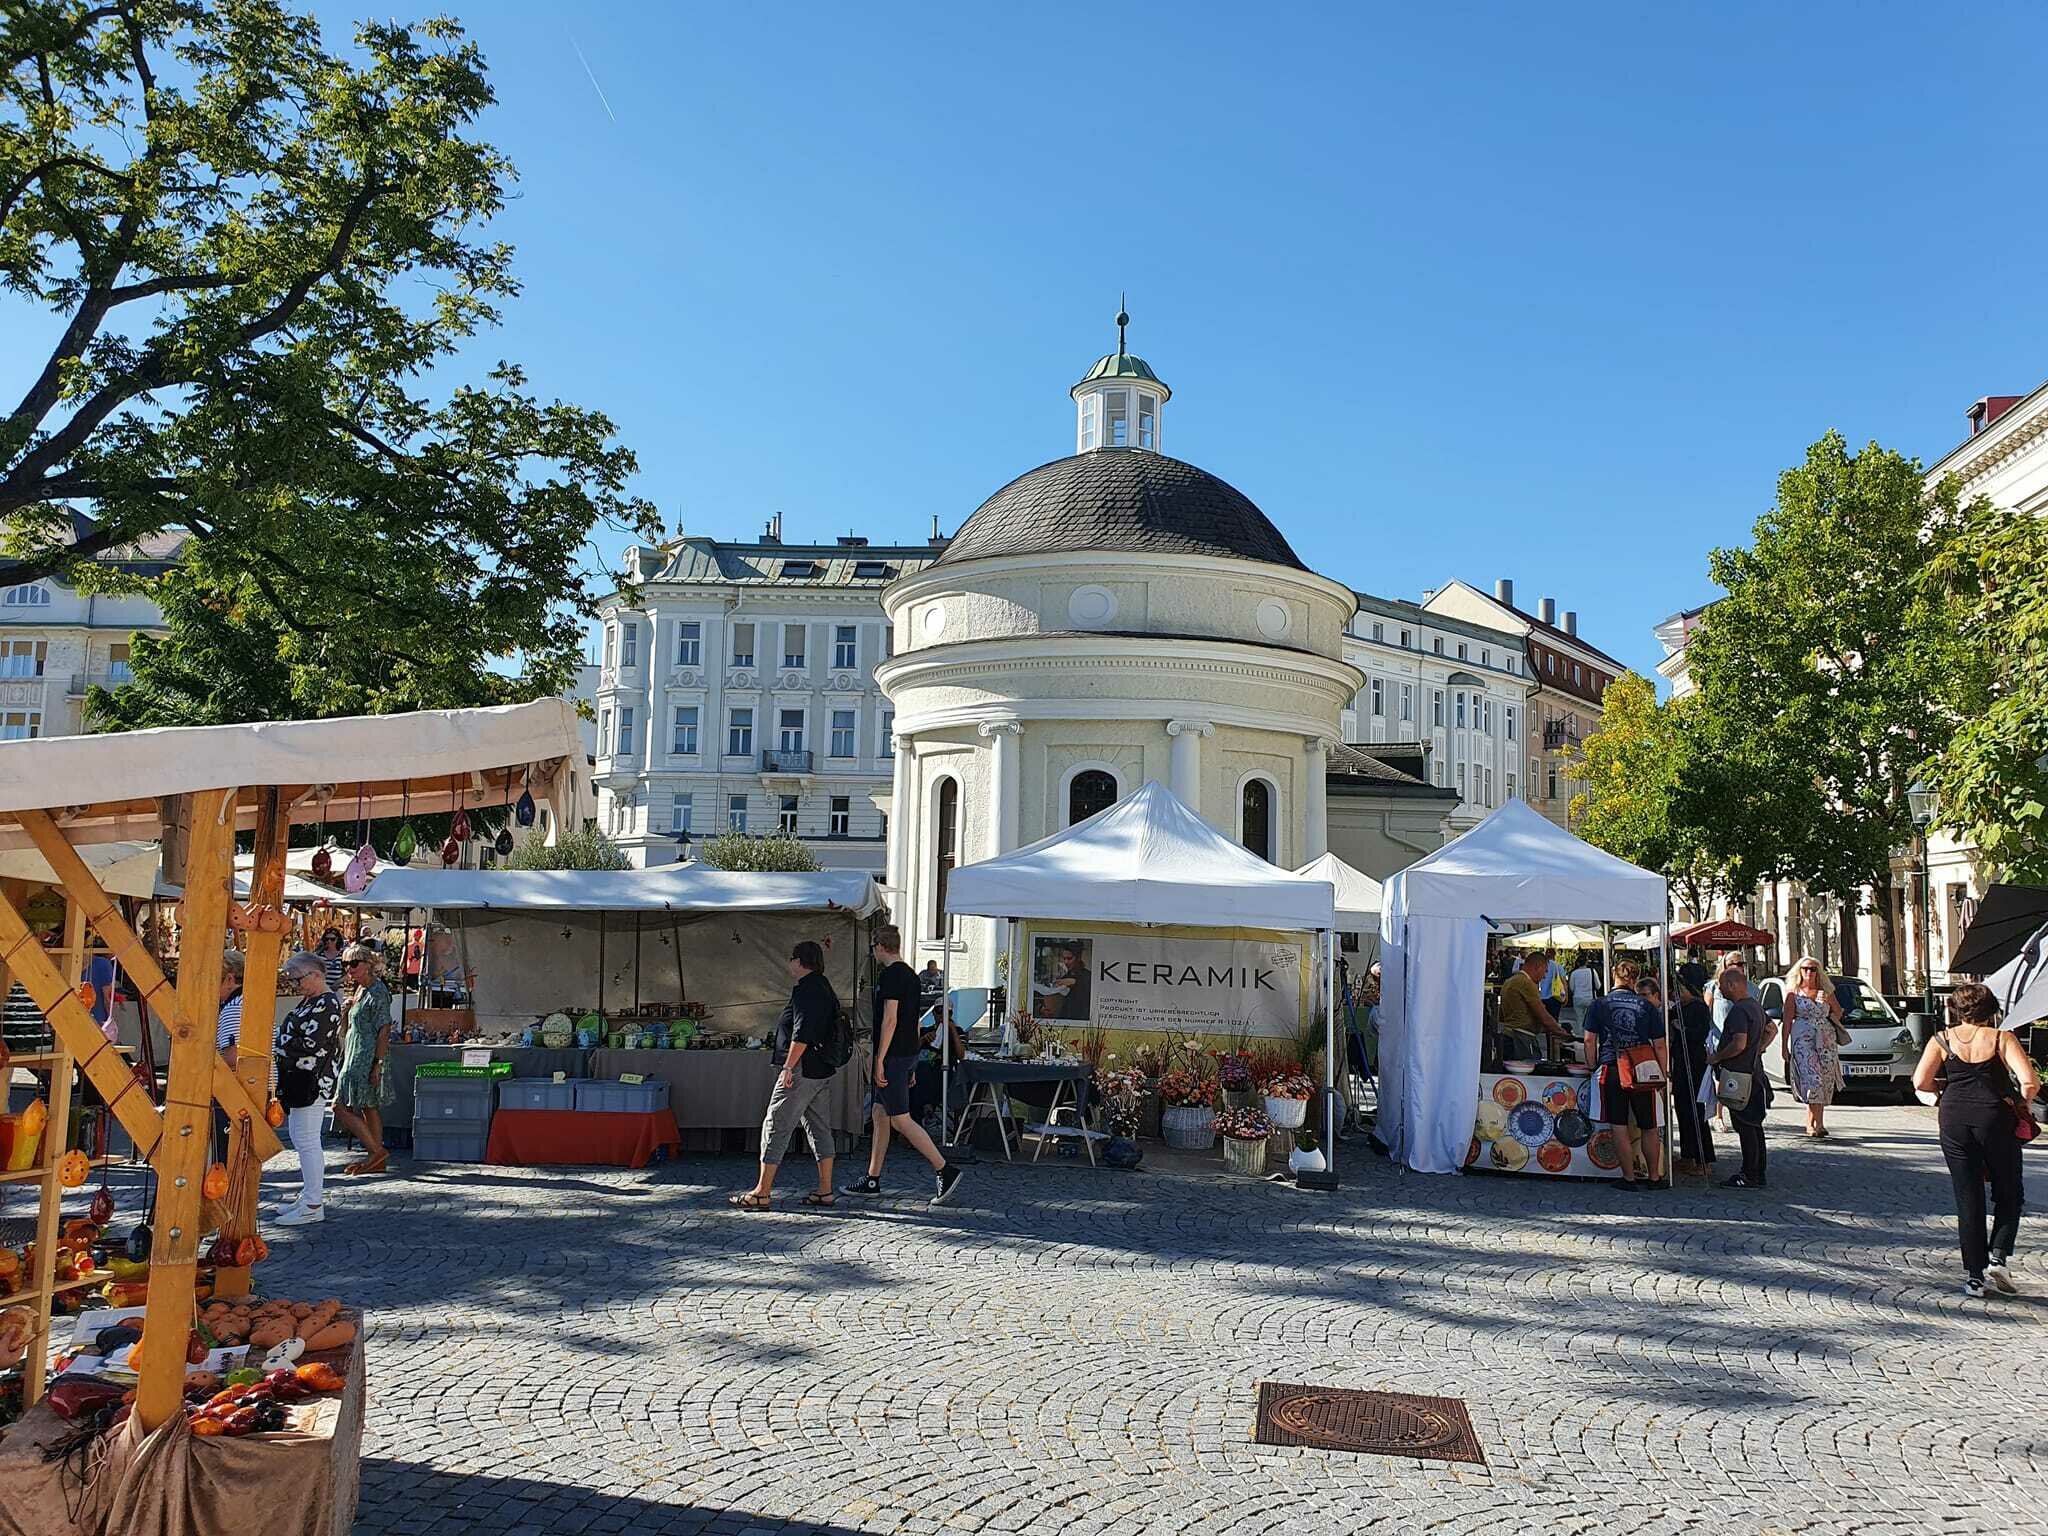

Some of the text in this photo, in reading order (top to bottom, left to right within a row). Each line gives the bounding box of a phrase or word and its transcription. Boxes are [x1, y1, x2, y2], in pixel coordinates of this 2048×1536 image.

[1100, 961, 1277, 991] KERAMIK
[1100, 997, 1138, 1005] COPYRIGHT
[1100, 1004, 1133, 1012] PRODUKT
